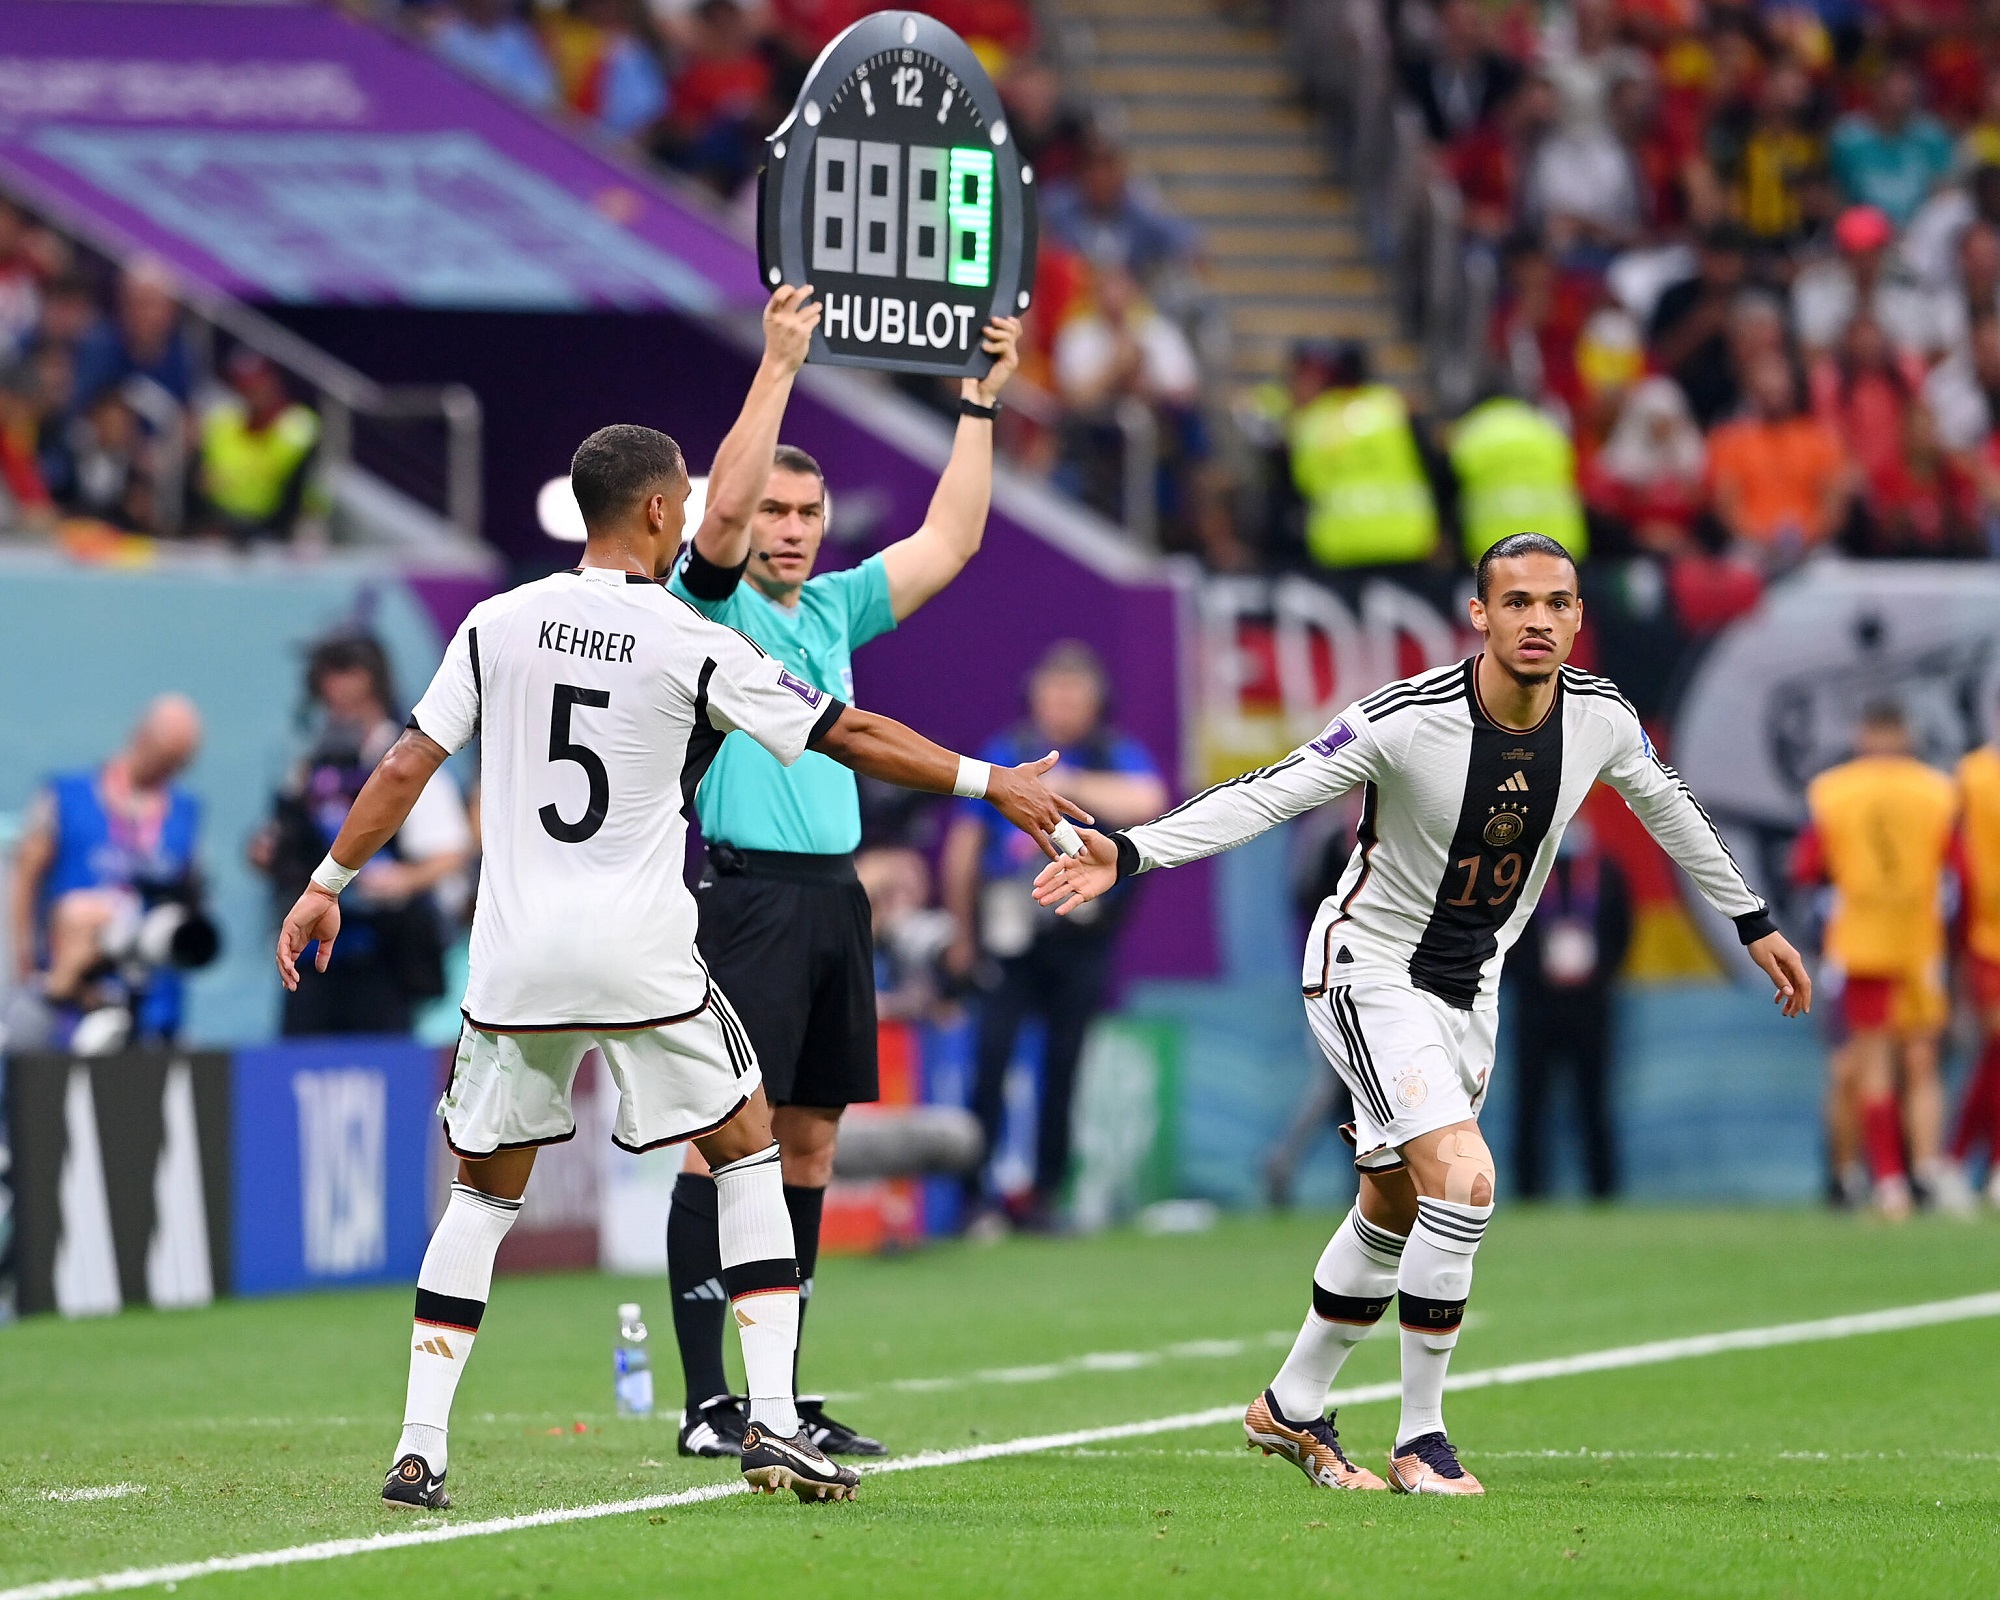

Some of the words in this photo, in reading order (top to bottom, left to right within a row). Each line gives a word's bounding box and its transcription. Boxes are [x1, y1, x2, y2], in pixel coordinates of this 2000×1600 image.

[891, 66, 924, 108] 12
[824, 292, 976, 351] HUBLOT
[538, 620, 636, 664] KEHRER
[538, 683, 610, 844] 5
[1446, 852, 1522, 906] 19
